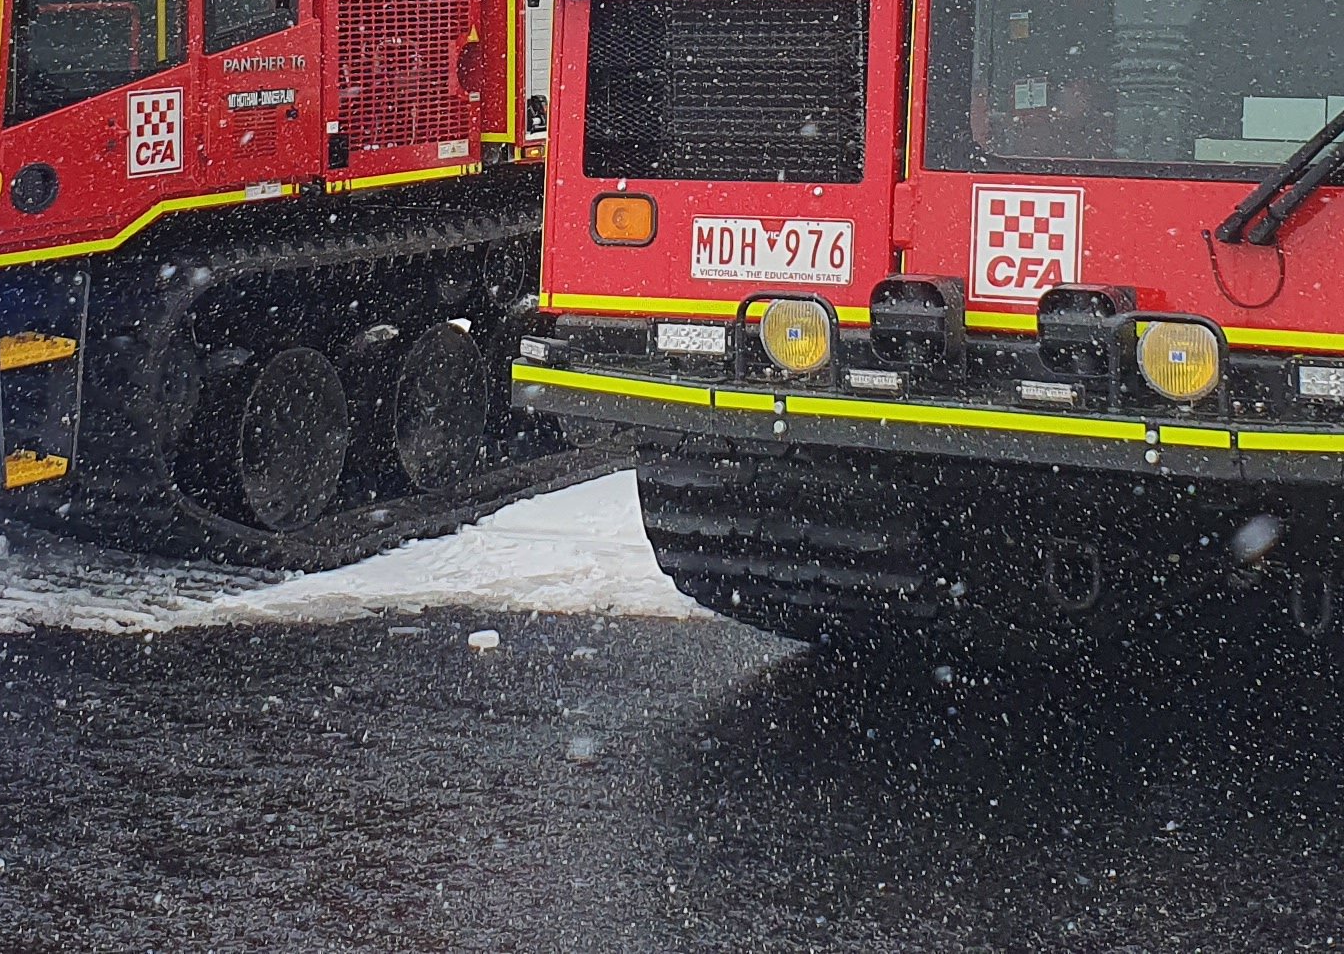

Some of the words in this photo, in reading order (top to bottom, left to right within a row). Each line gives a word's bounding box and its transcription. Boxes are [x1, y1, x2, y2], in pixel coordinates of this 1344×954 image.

[223, 55, 286, 73] PANTHER
[136, 139, 176, 166] CFA
[696, 226, 757, 266] MDH
[785, 228, 845, 269] 976
[699, 268, 738, 277] VICTORIA
[745, 270, 762, 278] THE
[764, 271, 814, 281] EDUCATION
[815, 273, 842, 282] STATE
[986, 255, 1063, 289] CFA
